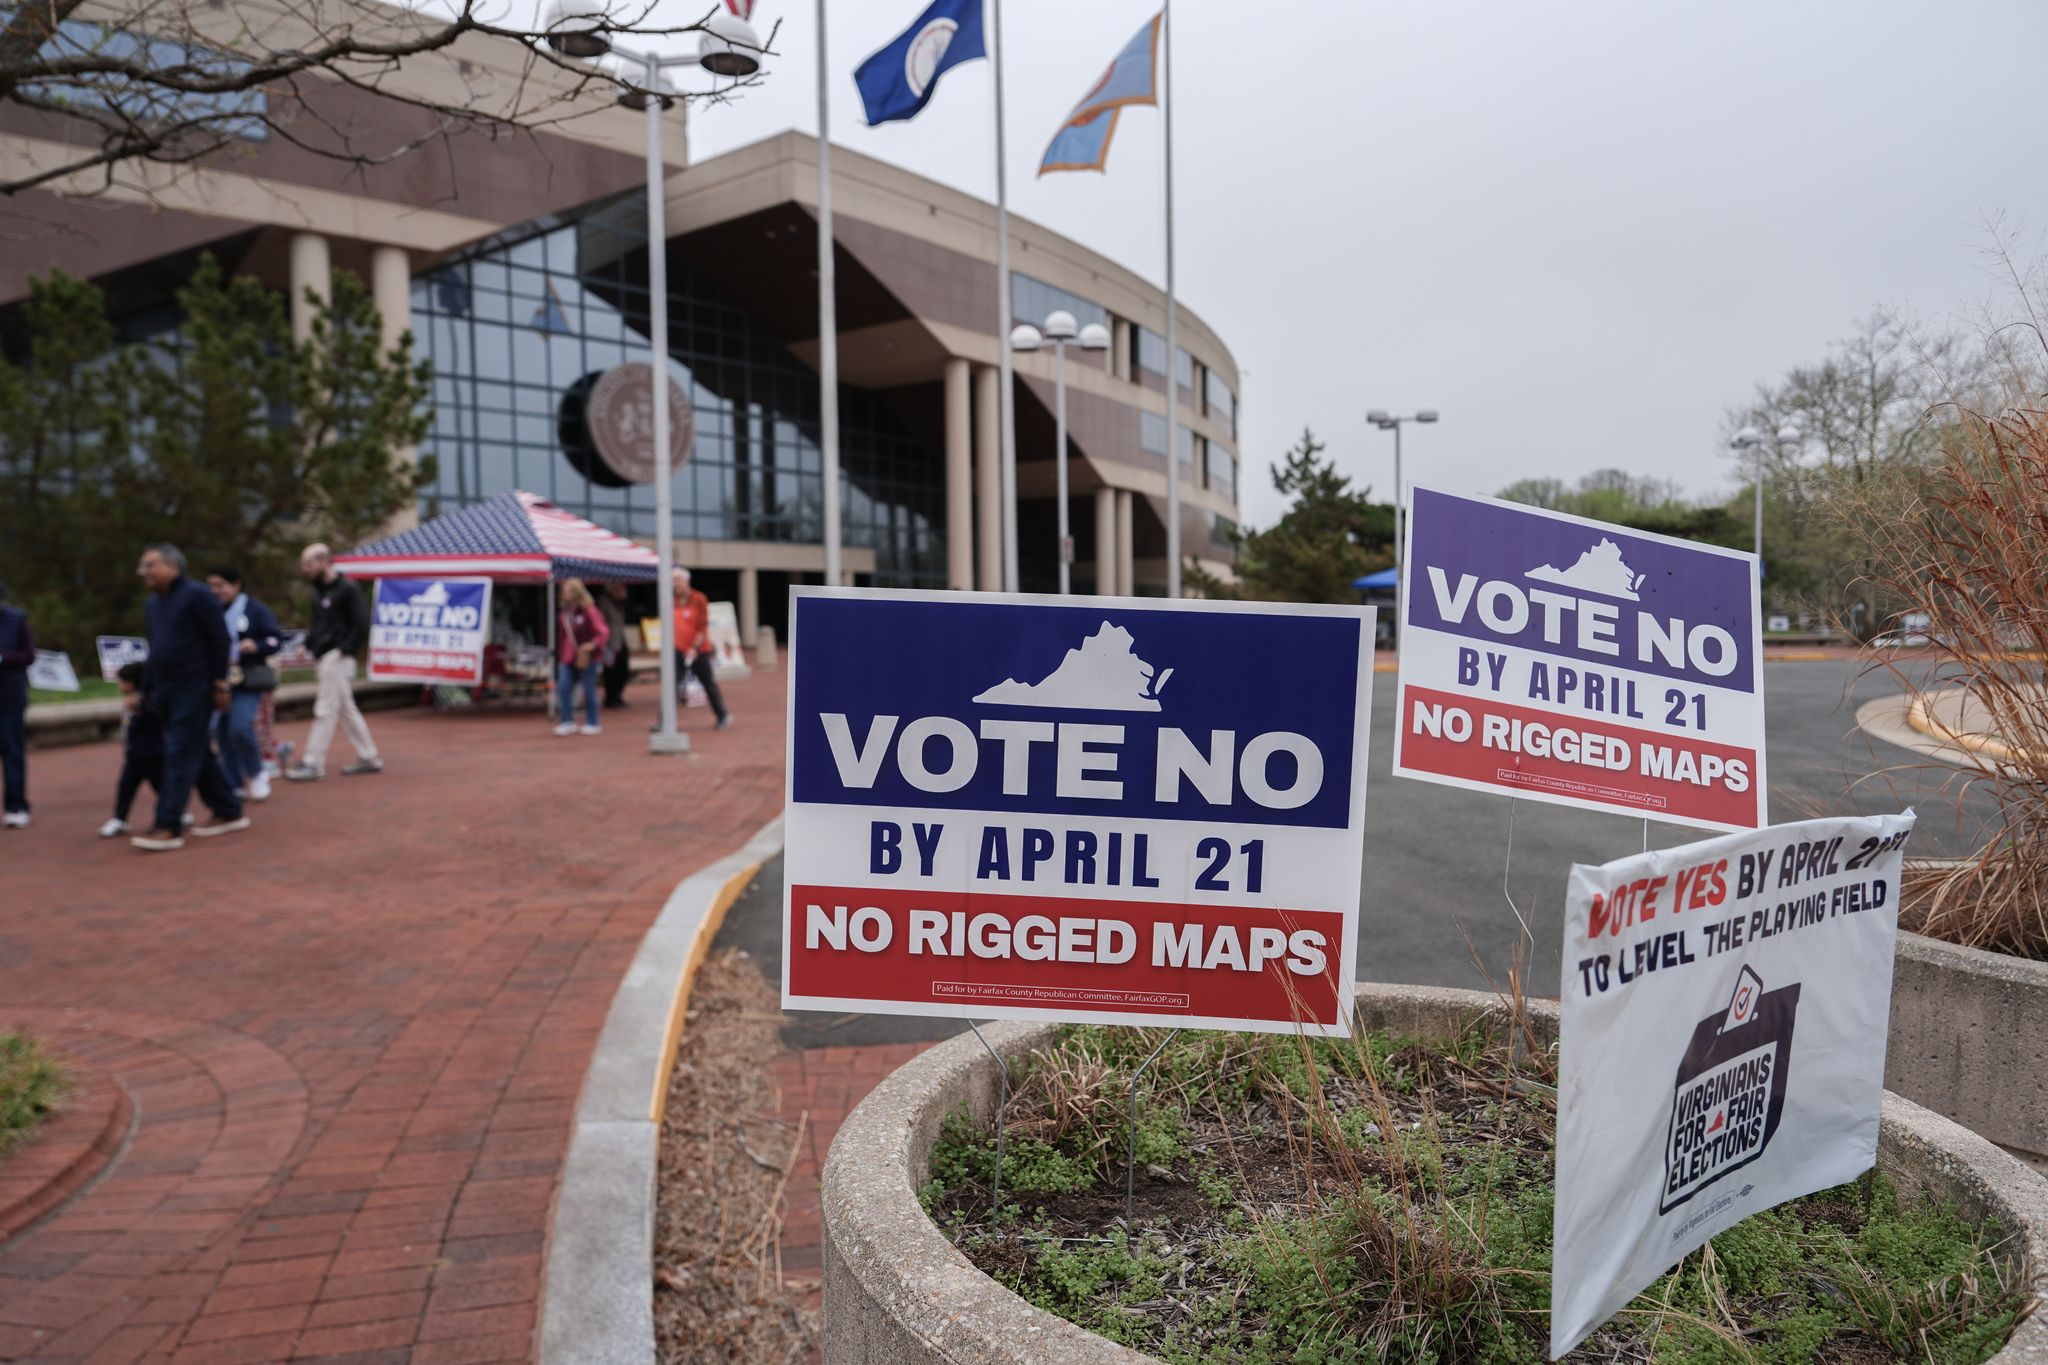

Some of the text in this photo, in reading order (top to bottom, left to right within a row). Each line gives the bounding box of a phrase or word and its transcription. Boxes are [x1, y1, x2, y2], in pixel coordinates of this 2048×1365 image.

[377, 602, 478, 629] VOTE NO
[1427, 566, 1738, 677] VOTE NO
[1457, 646, 1706, 731] BY APRIL 21
[820, 713, 1324, 809] VOTE NO
[1413, 700, 1749, 793] NO RIGGED MAPS
[870, 821, 1264, 893] BY APRIL 21
[1588, 875, 1669, 940] VOTE
[1673, 859, 1729, 913] YES
[1737, 847, 1774, 899] BY
[1778, 837, 1843, 888] APRIL
[806, 905, 1328, 975] NO RIGGED MAPS
[1578, 879, 1887, 997] TO LEVEL THE PLAYING FIELD
[937, 985, 953, 993] Paid
[955, 985, 966, 993] for
[968, 986, 978, 995] by
[979, 986, 1003, 995] Fairfax
[1005, 988, 1033, 998] County
[1034, 989, 1077, 999] Republican
[1079, 991, 1123, 1001] Committee,
[1674, 1086, 1766, 1161] FOR FAIR
[1678, 1053, 1771, 1126] VIRGINIANS
[1668, 1116, 1762, 1196] ELECTIONS
